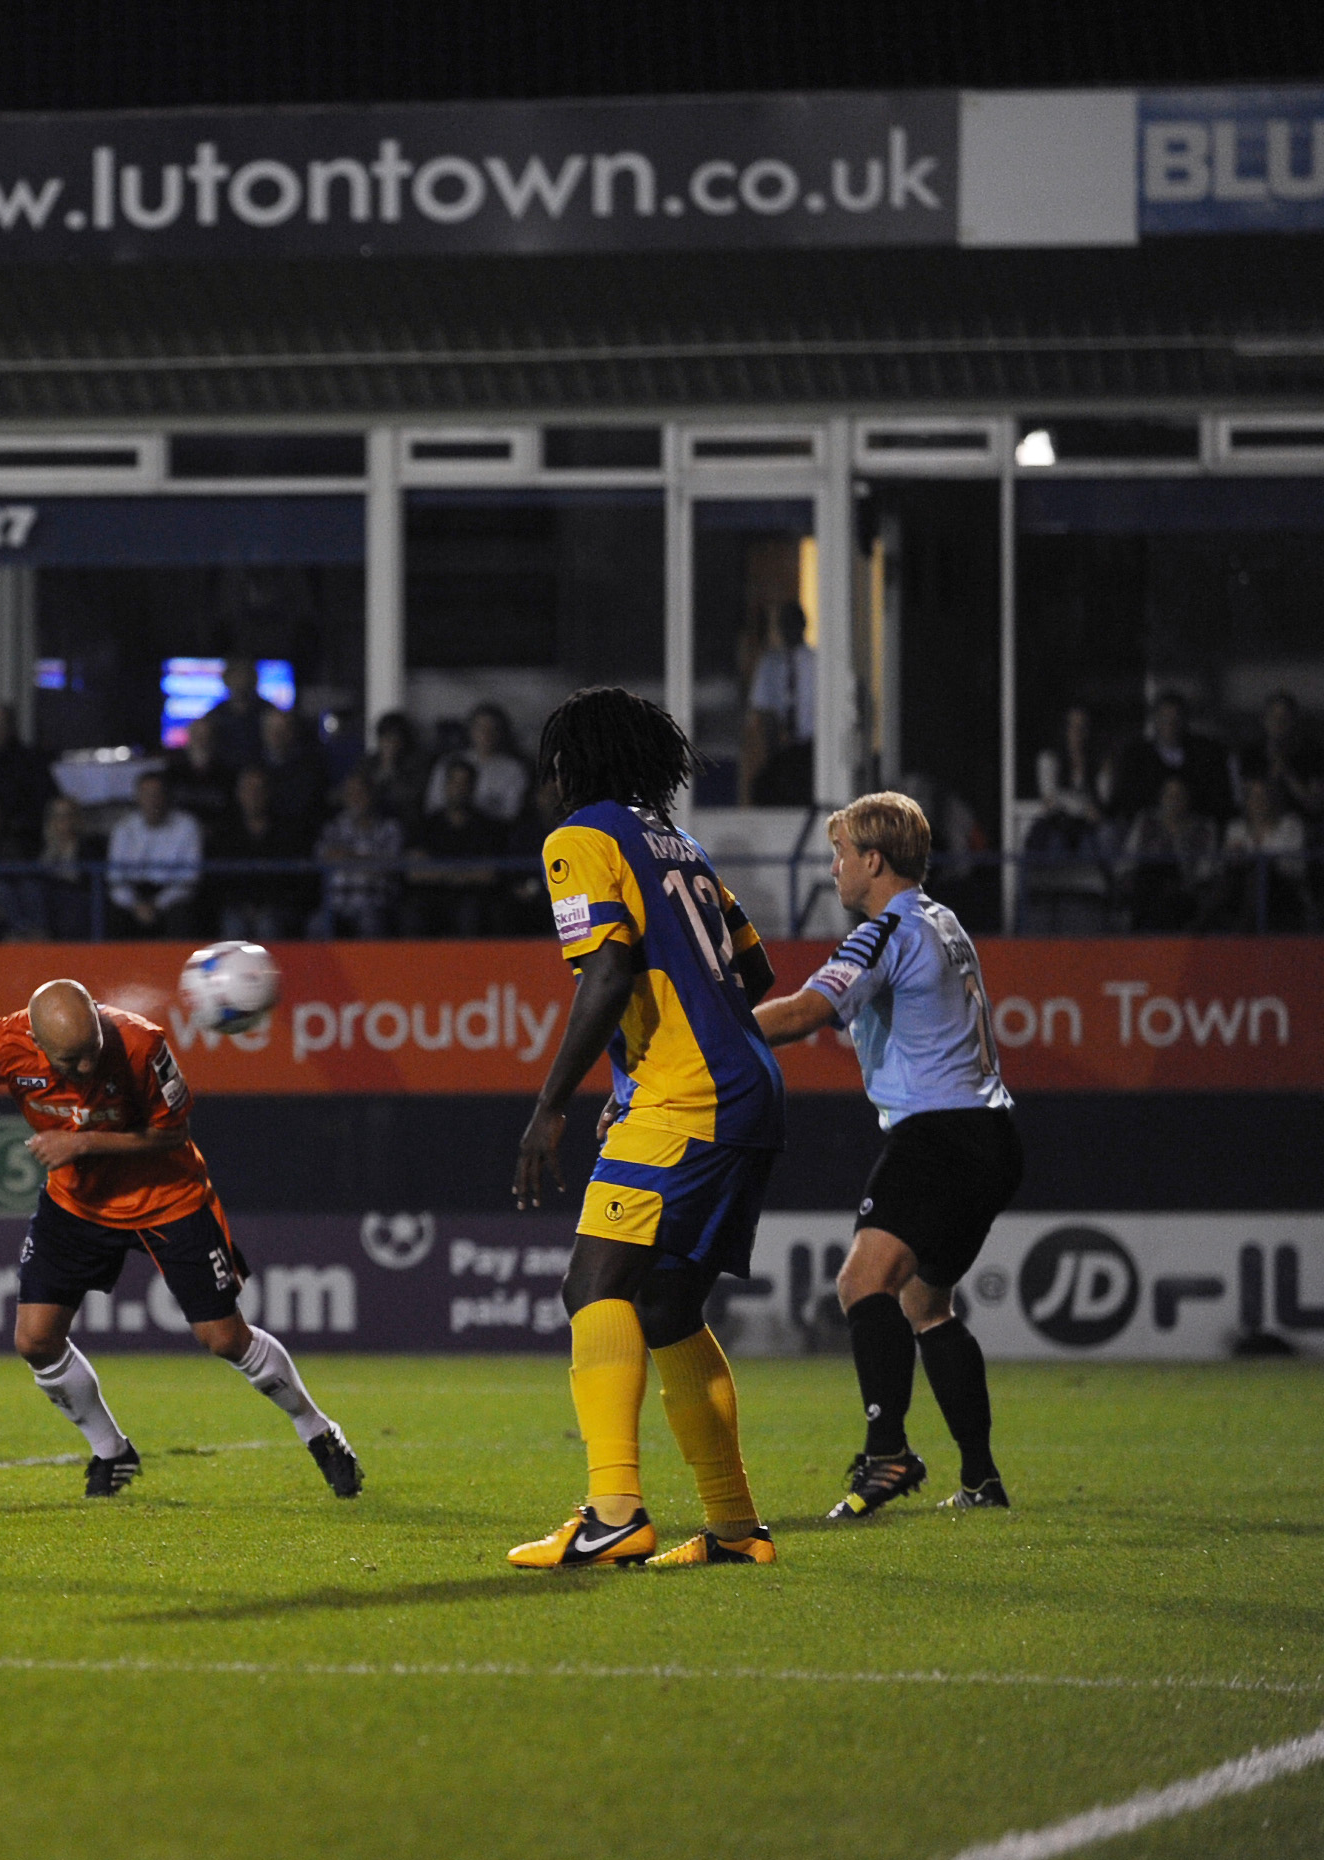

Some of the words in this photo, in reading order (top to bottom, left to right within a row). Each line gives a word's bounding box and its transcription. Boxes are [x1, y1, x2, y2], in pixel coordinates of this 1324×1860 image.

[291, 981, 560, 1063] proudly
[1102, 979, 1290, 1049] Town
[450, 1238, 519, 1284] Pay
[1032, 1249, 1133, 1322] JD
[450, 1288, 530, 1334] paid
